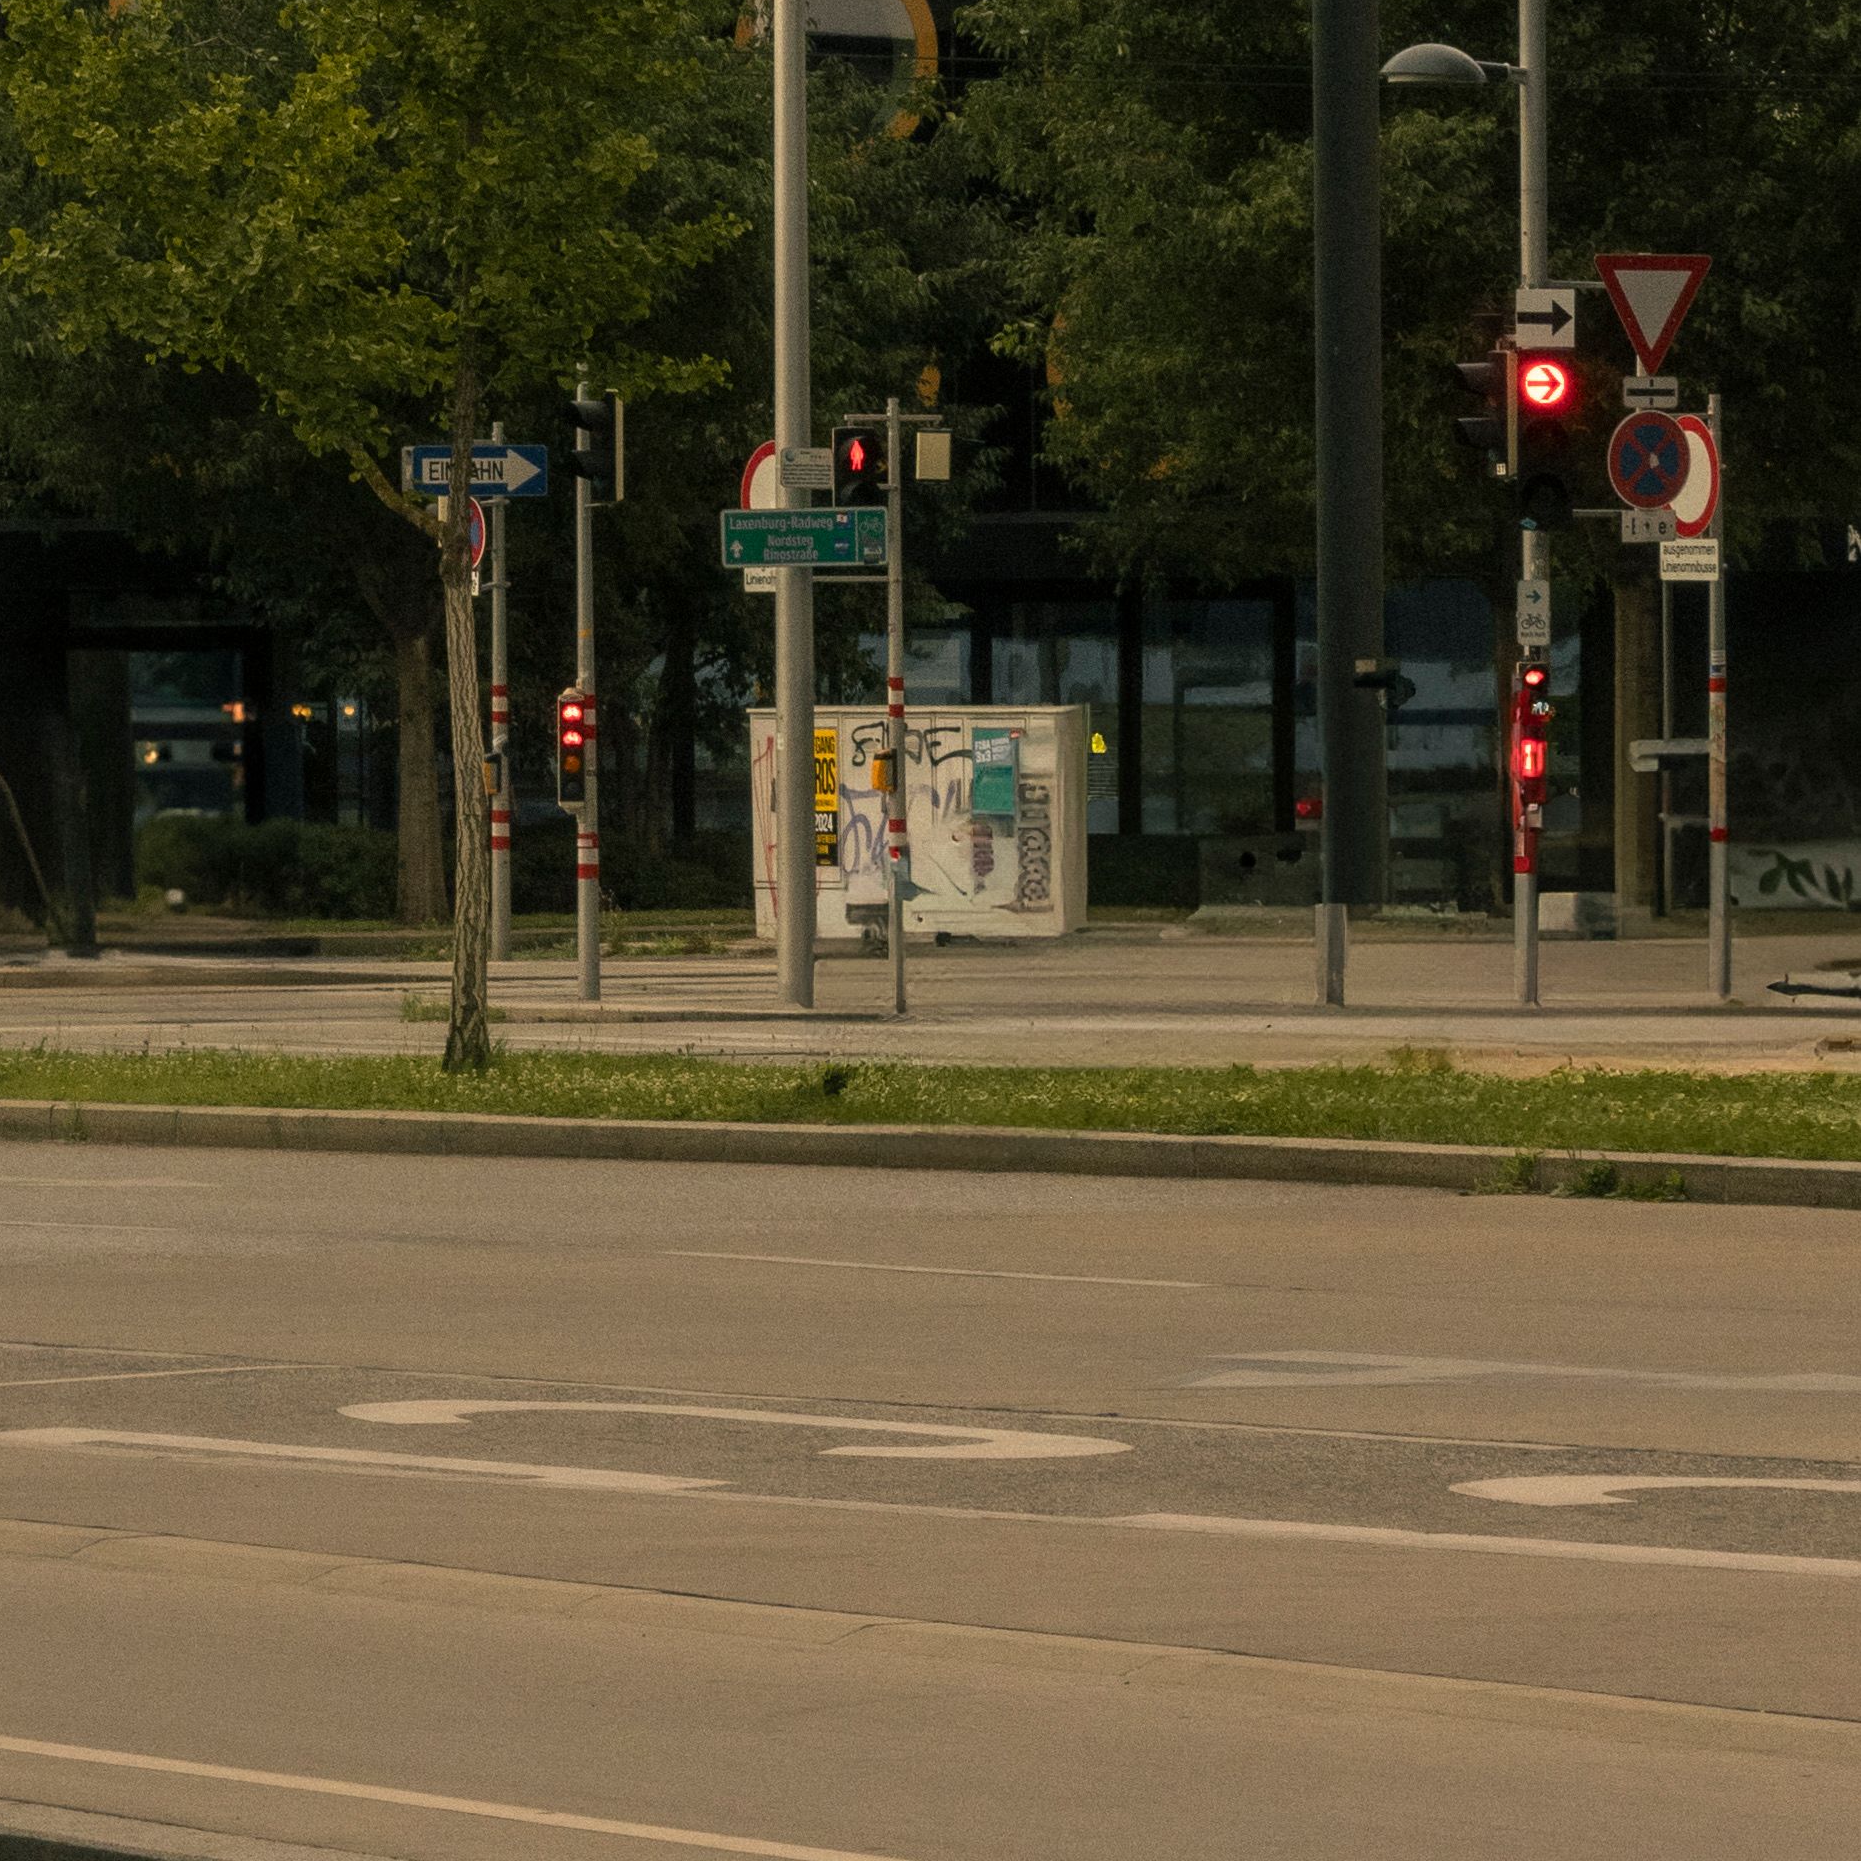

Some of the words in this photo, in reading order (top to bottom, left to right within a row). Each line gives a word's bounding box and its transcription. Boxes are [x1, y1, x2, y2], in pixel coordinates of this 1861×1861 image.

[429, 461, 504, 481] EINAHN
[767, 535, 814, 548] Nordsteg
[1663, 545, 1715, 558] ausgenommen
[1662, 560, 1717, 573] Linienomnibusse
